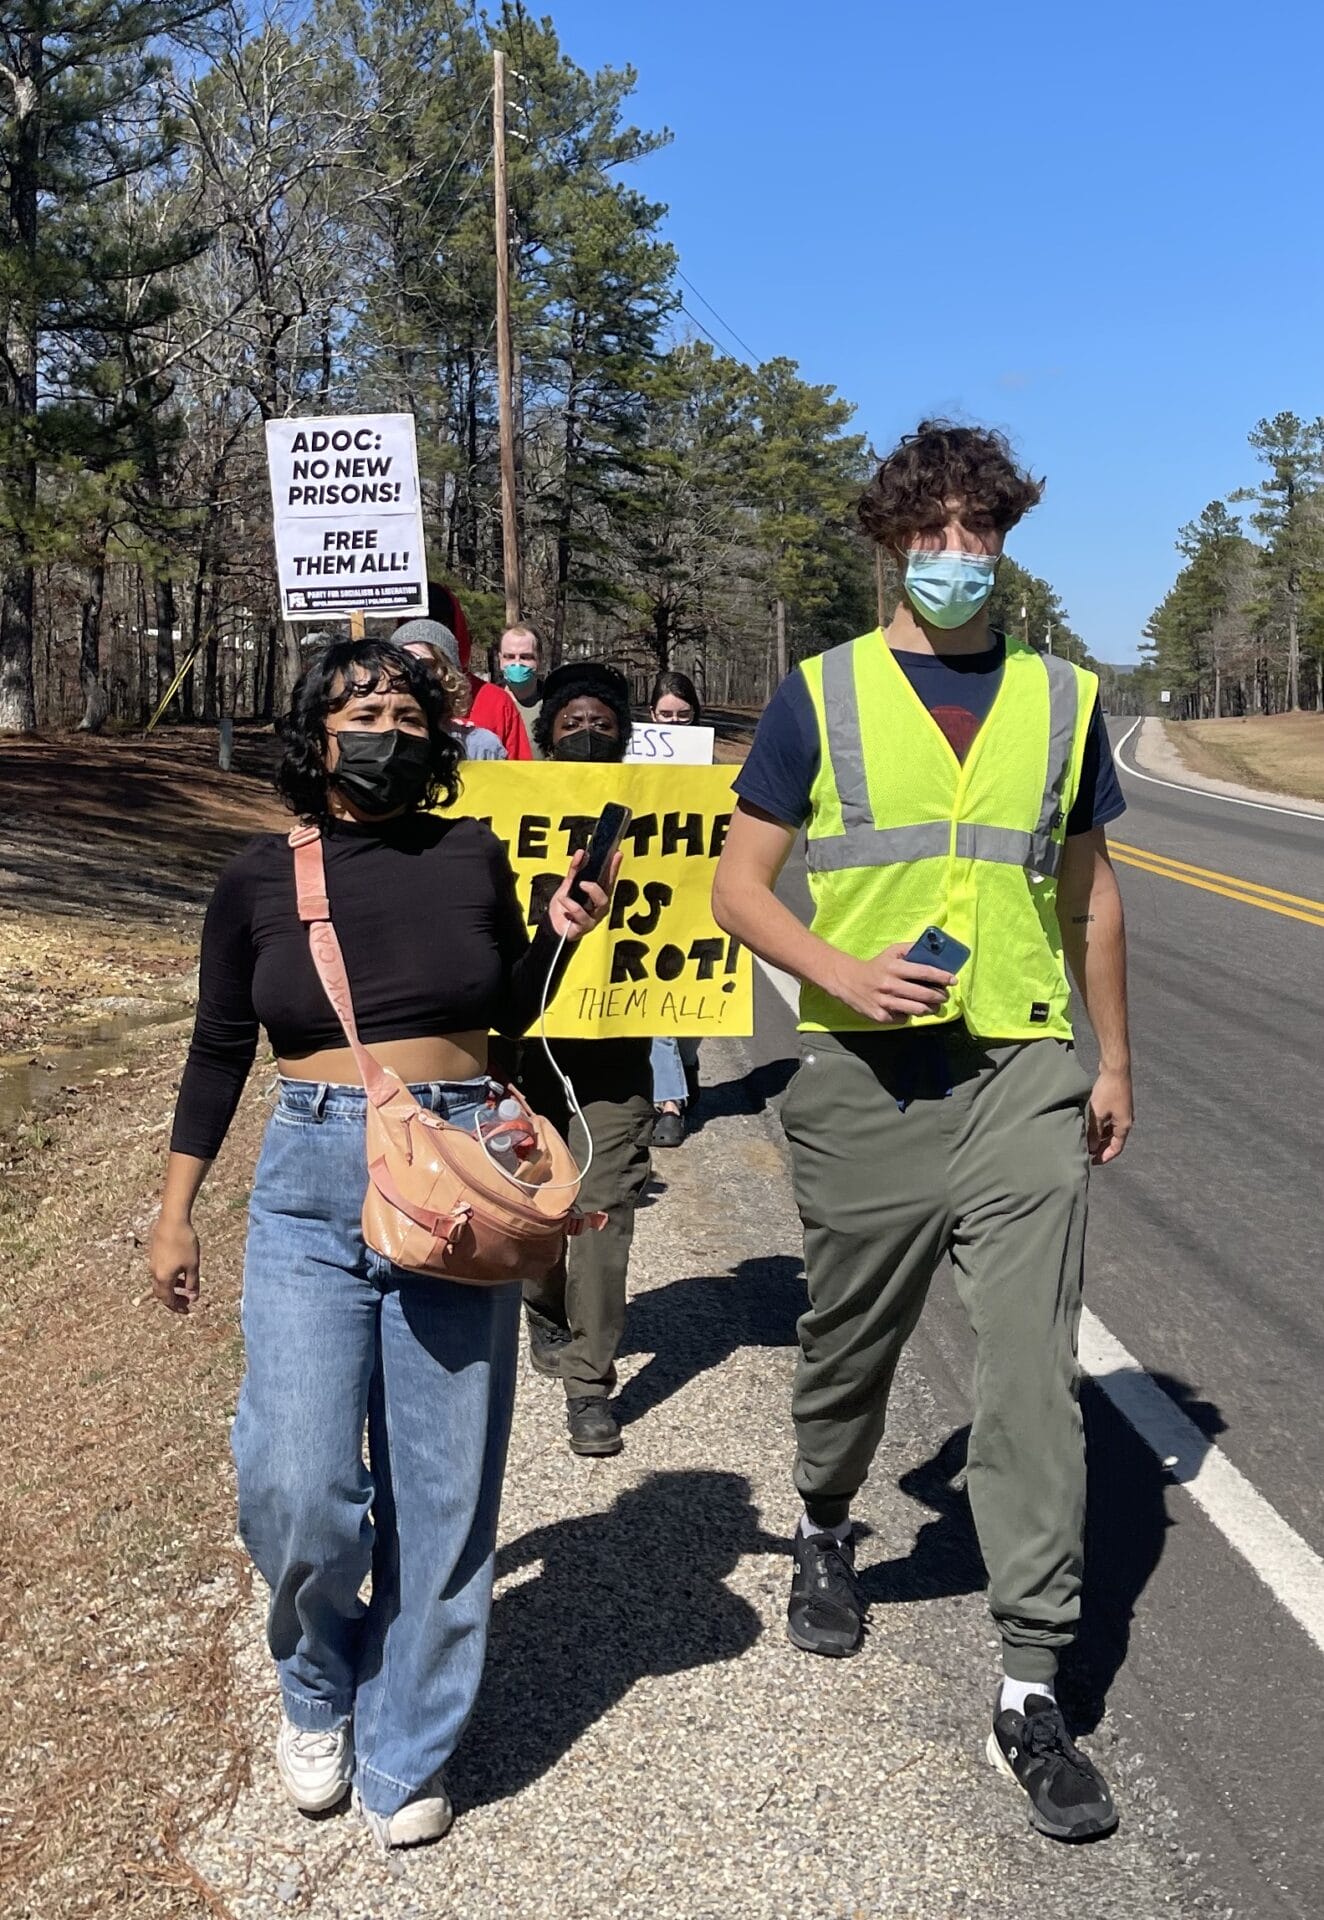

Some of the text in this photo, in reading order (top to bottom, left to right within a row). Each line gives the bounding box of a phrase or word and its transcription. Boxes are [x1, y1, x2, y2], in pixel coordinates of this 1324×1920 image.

[291, 429, 383, 453] ADOC:
[293, 456, 393, 480] NO NEW
[288, 482, 401, 505] PRISONS!
[323, 529, 378, 551] FREE
[293, 552, 410, 576] THEM ALL!
[627, 729, 674, 757] ESS
[479, 815, 600, 858] ET
[610, 935, 740, 993] ROT!
[578, 988, 726, 1023] THEM ALL!
